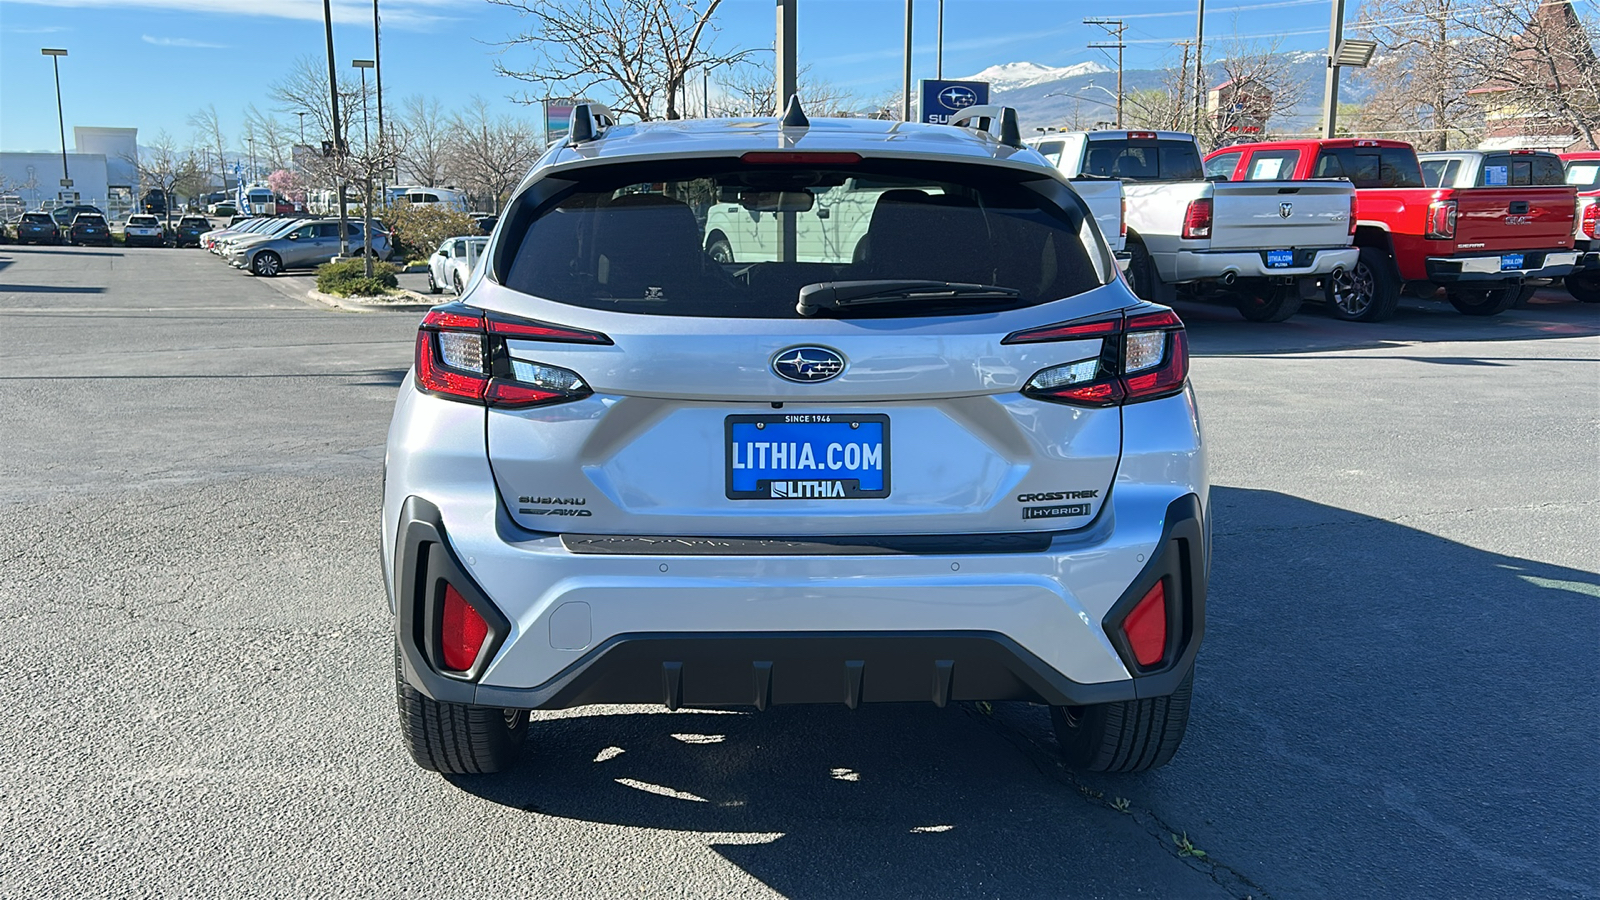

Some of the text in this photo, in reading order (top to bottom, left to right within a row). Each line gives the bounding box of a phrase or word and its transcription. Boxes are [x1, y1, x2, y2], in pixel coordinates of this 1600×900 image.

[785, 415, 831, 423] SINCE 1946
[732, 442, 883, 470] LITHIA.COM
[787, 481, 846, 498] LITHIA
[518, 496, 586, 506] SUBARU
[1017, 490, 1099, 503] CROSSTREK
[547, 508, 593, 517] AWD
[1033, 507, 1081, 516] HYBRID
